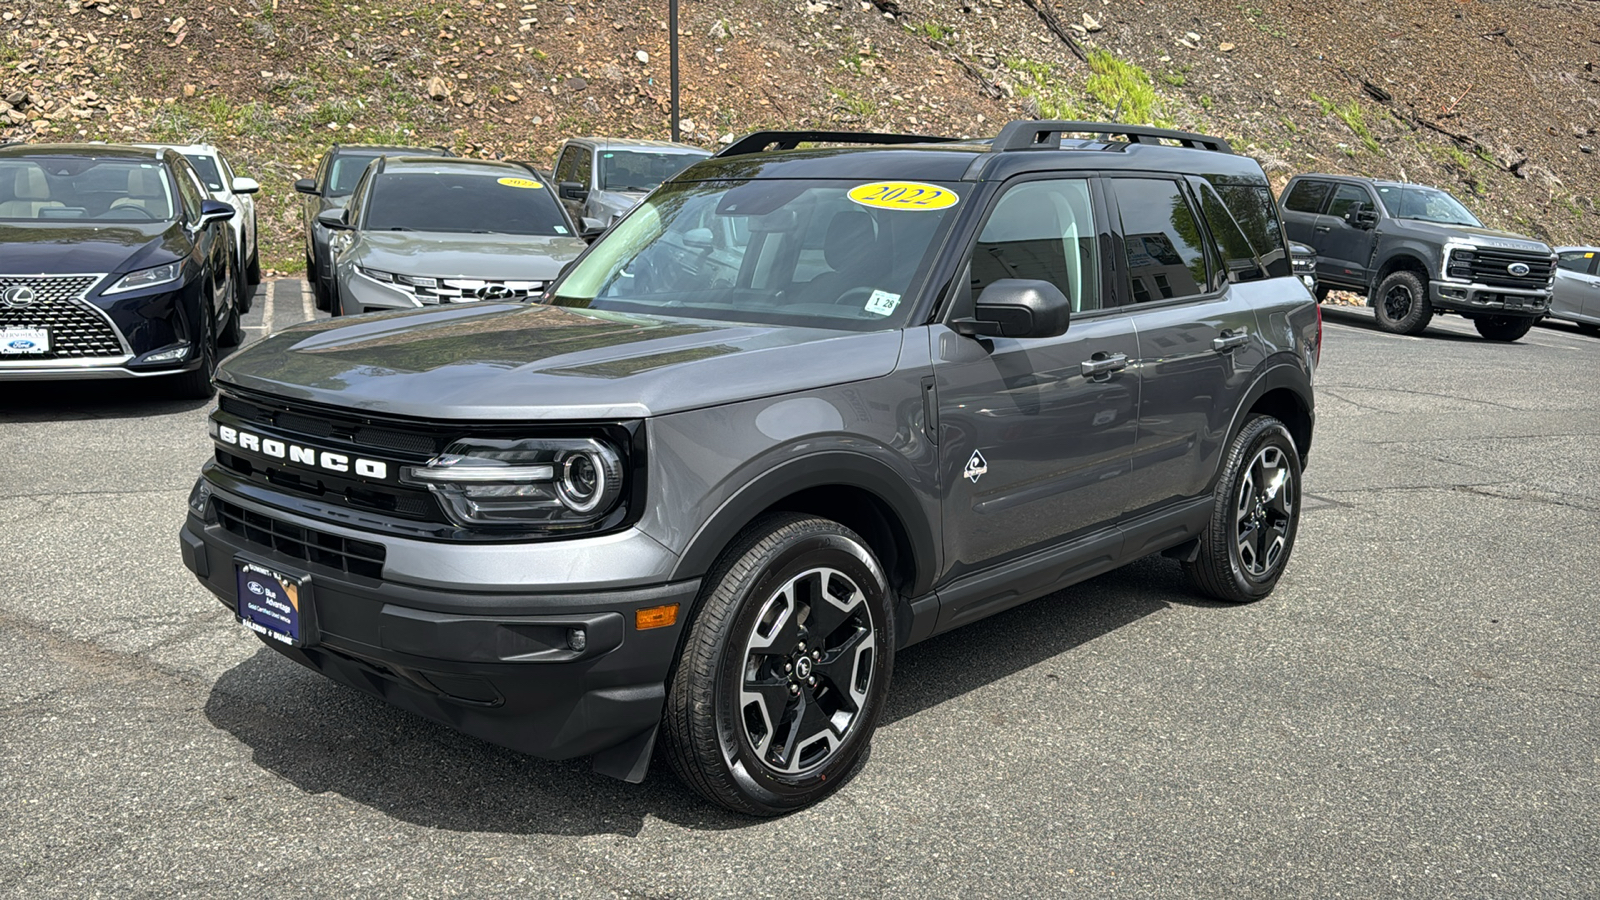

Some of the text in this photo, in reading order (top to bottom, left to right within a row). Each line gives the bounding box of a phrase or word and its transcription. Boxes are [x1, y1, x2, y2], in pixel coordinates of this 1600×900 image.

[861, 186, 942, 205] 2022
[874, 297, 895, 309] 1 28
[219, 425, 387, 480] BRONCO
[265, 588, 276, 599] Blue
[266, 597, 291, 614] Advantage
[242, 619, 266, 634] SALERNO
[273, 632, 293, 645] DUANE
